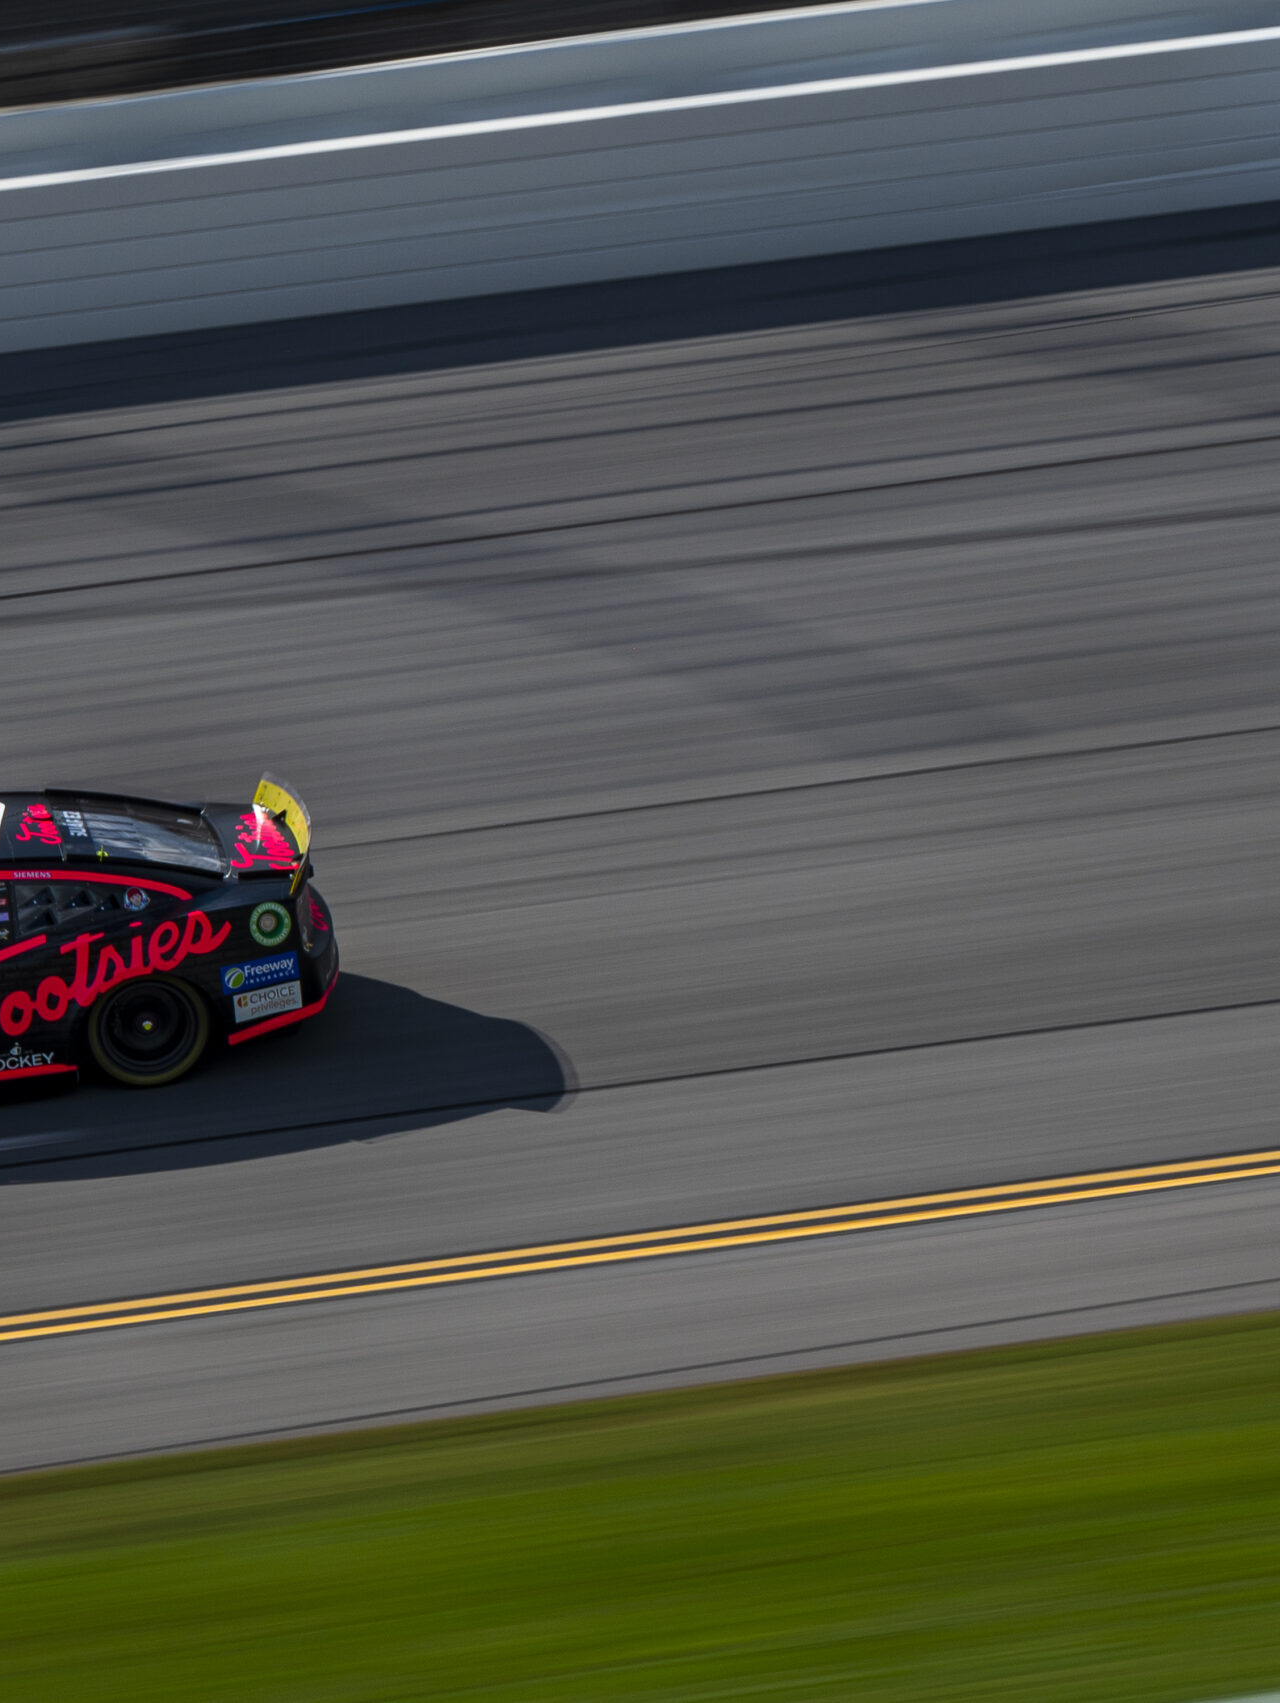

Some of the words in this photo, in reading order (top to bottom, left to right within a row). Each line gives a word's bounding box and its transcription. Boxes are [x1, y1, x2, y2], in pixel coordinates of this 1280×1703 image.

[13, 870, 52, 879] SIEMENS
[243, 957, 295, 977] Freeway
[245, 969, 296, 985] INSURANCE
[249, 985, 296, 1005] CHOICE
